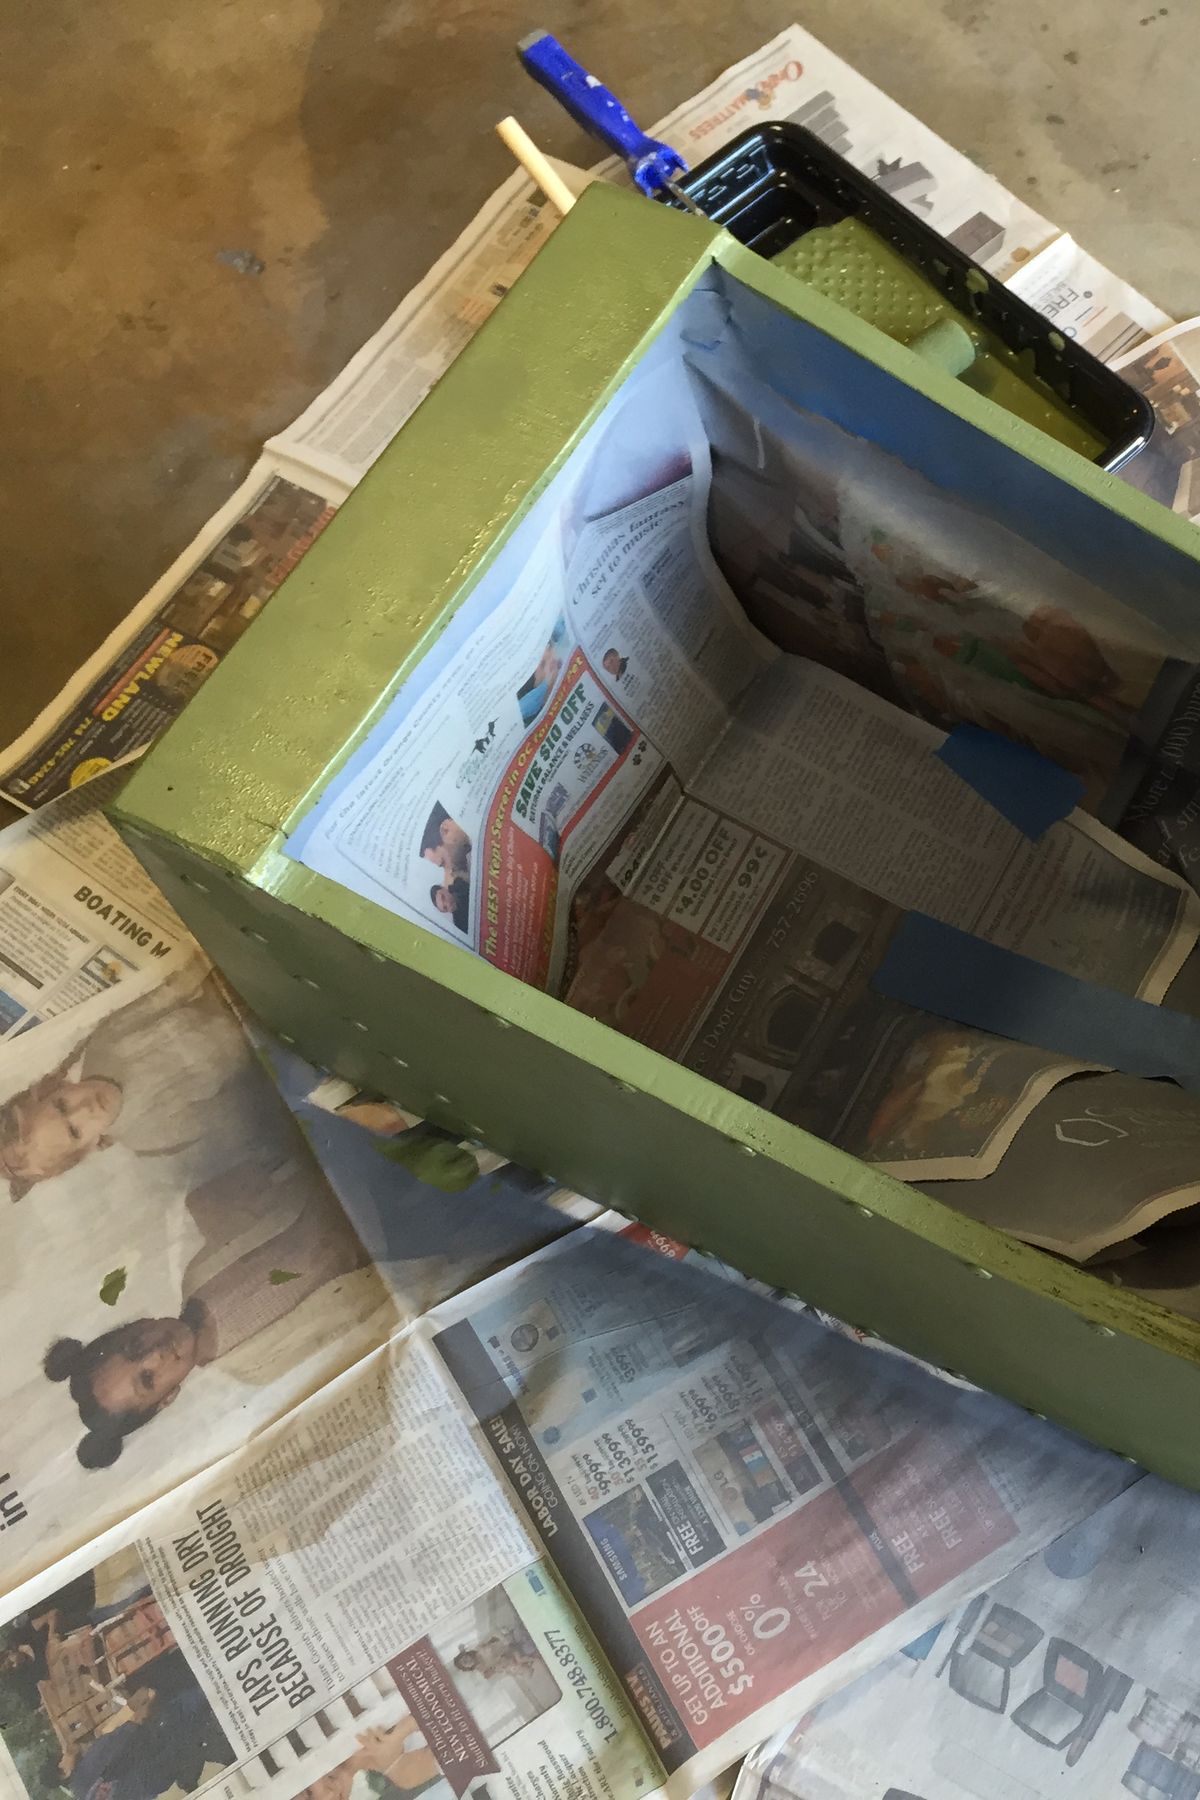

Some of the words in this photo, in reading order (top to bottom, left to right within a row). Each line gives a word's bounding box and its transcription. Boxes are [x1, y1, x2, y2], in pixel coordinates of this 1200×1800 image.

[620, 516, 663, 554] music
[99, 628, 184, 725] NEWLAND
[515, 759, 545, 818] SAVE
[558, 681, 590, 727] OFF
[515, 744, 533, 767] OC
[528, 784, 544, 824] NATURAL
[540, 745, 566, 786] BALANCE
[565, 700, 595, 742] WELLNESS
[506, 768, 521, 785] in
[488, 785, 512, 838] Secret
[488, 838, 503, 878] Kept
[702, 826, 733, 866] OFF
[72, 881, 154, 950] BOATING
[485, 879, 500, 924] BEST
[485, 925, 498, 957] The
[700, 1002, 737, 1050] Door
[726, 966, 760, 1007] Guy
[486, 1413, 518, 1454] SALE!
[506, 1422, 532, 1455] NOW!
[507, 1453, 534, 1487] DAY
[522, 1451, 542, 1474] ON
[711, 1469, 728, 1489] LG
[532, 1470, 560, 1509] GOING
[523, 1485, 561, 1537] LABOR
[167, 1526, 213, 1573] DRY
[187, 1496, 260, 1588] DROUGHT
[675, 1519, 704, 1555] FREE
[889, 1529, 926, 1575] FREE
[598, 1536, 629, 1581] SAMSUNG
[263, 1565, 288, 1601] bottled
[279, 1569, 299, 1596] have
[790, 1556, 831, 1600] 24
[184, 1566, 255, 1662] RUNNING
[231, 1583, 269, 1619] OF
[280, 1597, 306, 1633] delivers
[291, 1592, 310, 1617] wells
[684, 1601, 712, 1633] OFF
[736, 1582, 796, 1644] 0%
[303, 1614, 324, 1643] whose
[643, 1619, 670, 1649] AN
[724, 1607, 750, 1643] CHOOSE
[245, 1611, 317, 1709] BECAUSE
[298, 1630, 323, 1664] County
[317, 1640, 341, 1673] houses
[657, 1645, 683, 1674] TO
[660, 1607, 730, 1713] ADDITIONAL
[694, 1619, 758, 1699] $500
[742, 1640, 757, 1657] OR
[231, 1655, 283, 1717] TAPS
[314, 1661, 337, 1691] Tulare
[334, 1670, 346, 1683] to
[403, 1654, 453, 1734] ECONOMICAL
[543, 1624, 621, 1746] 1.800.748.8377
[670, 1668, 694, 1695] UP
[436, 1681, 457, 1709] every
[682, 1692, 711, 1727] GET
[449, 1707, 463, 1721] fit
[456, 1719, 469, 1732] to
[446, 1731, 469, 1761] NEW
[462, 1731, 489, 1768] Shutter
[573, 1727, 597, 1761] Factory
[590, 1760, 603, 1774] the
[596, 1772, 612, 1792] ARE
